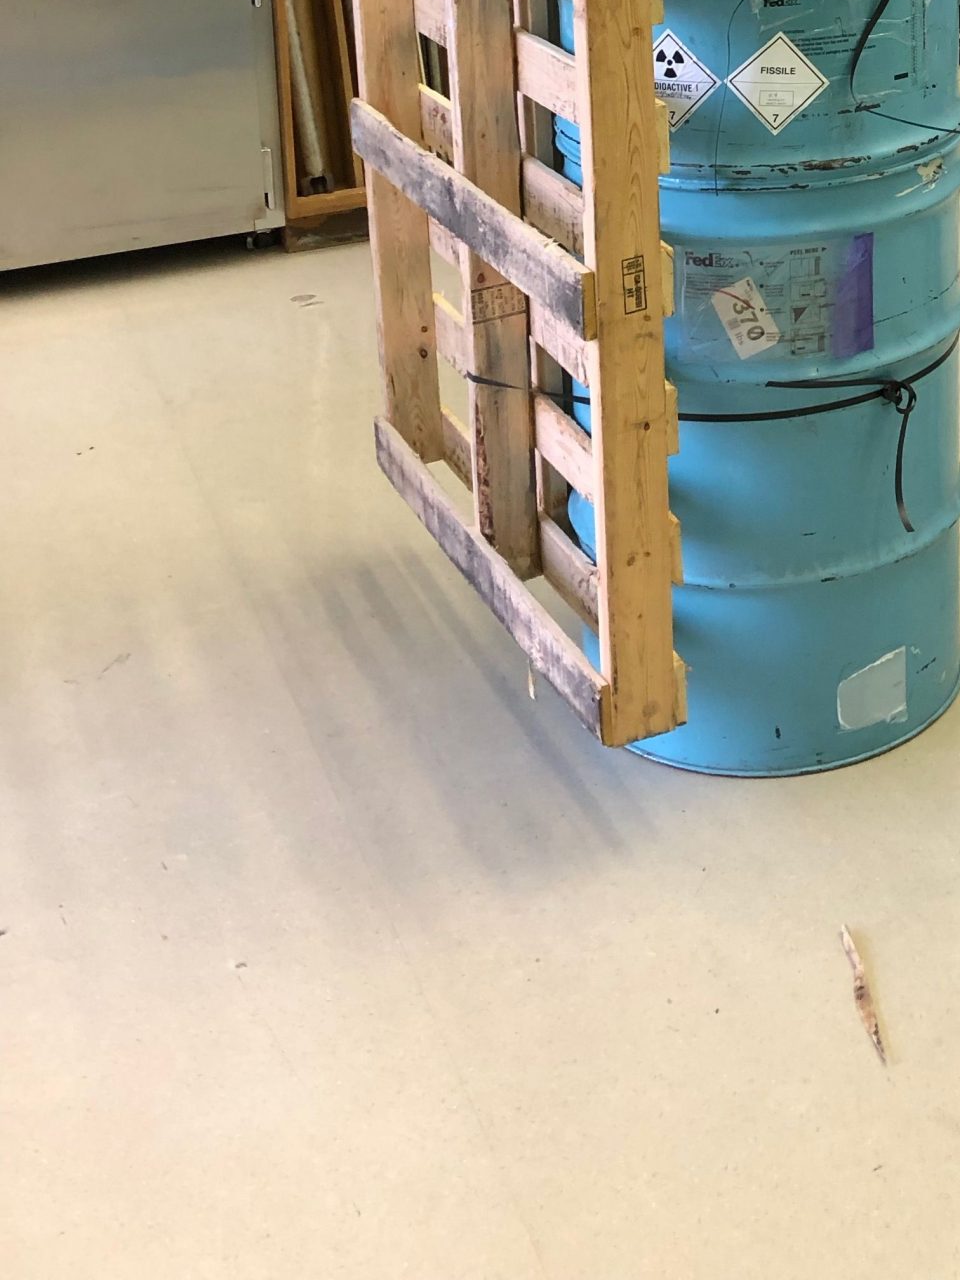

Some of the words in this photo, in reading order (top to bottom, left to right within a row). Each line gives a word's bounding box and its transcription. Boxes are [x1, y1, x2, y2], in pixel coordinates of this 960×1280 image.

[760, 66, 796, 75] FISSILE
[654, 81, 693, 93] DIOACTIVE
[669, 111, 676, 120] 7
[772, 114, 779, 123] 7
[685, 251, 734, 268] FedEx
[733, 300, 765, 341] 370
